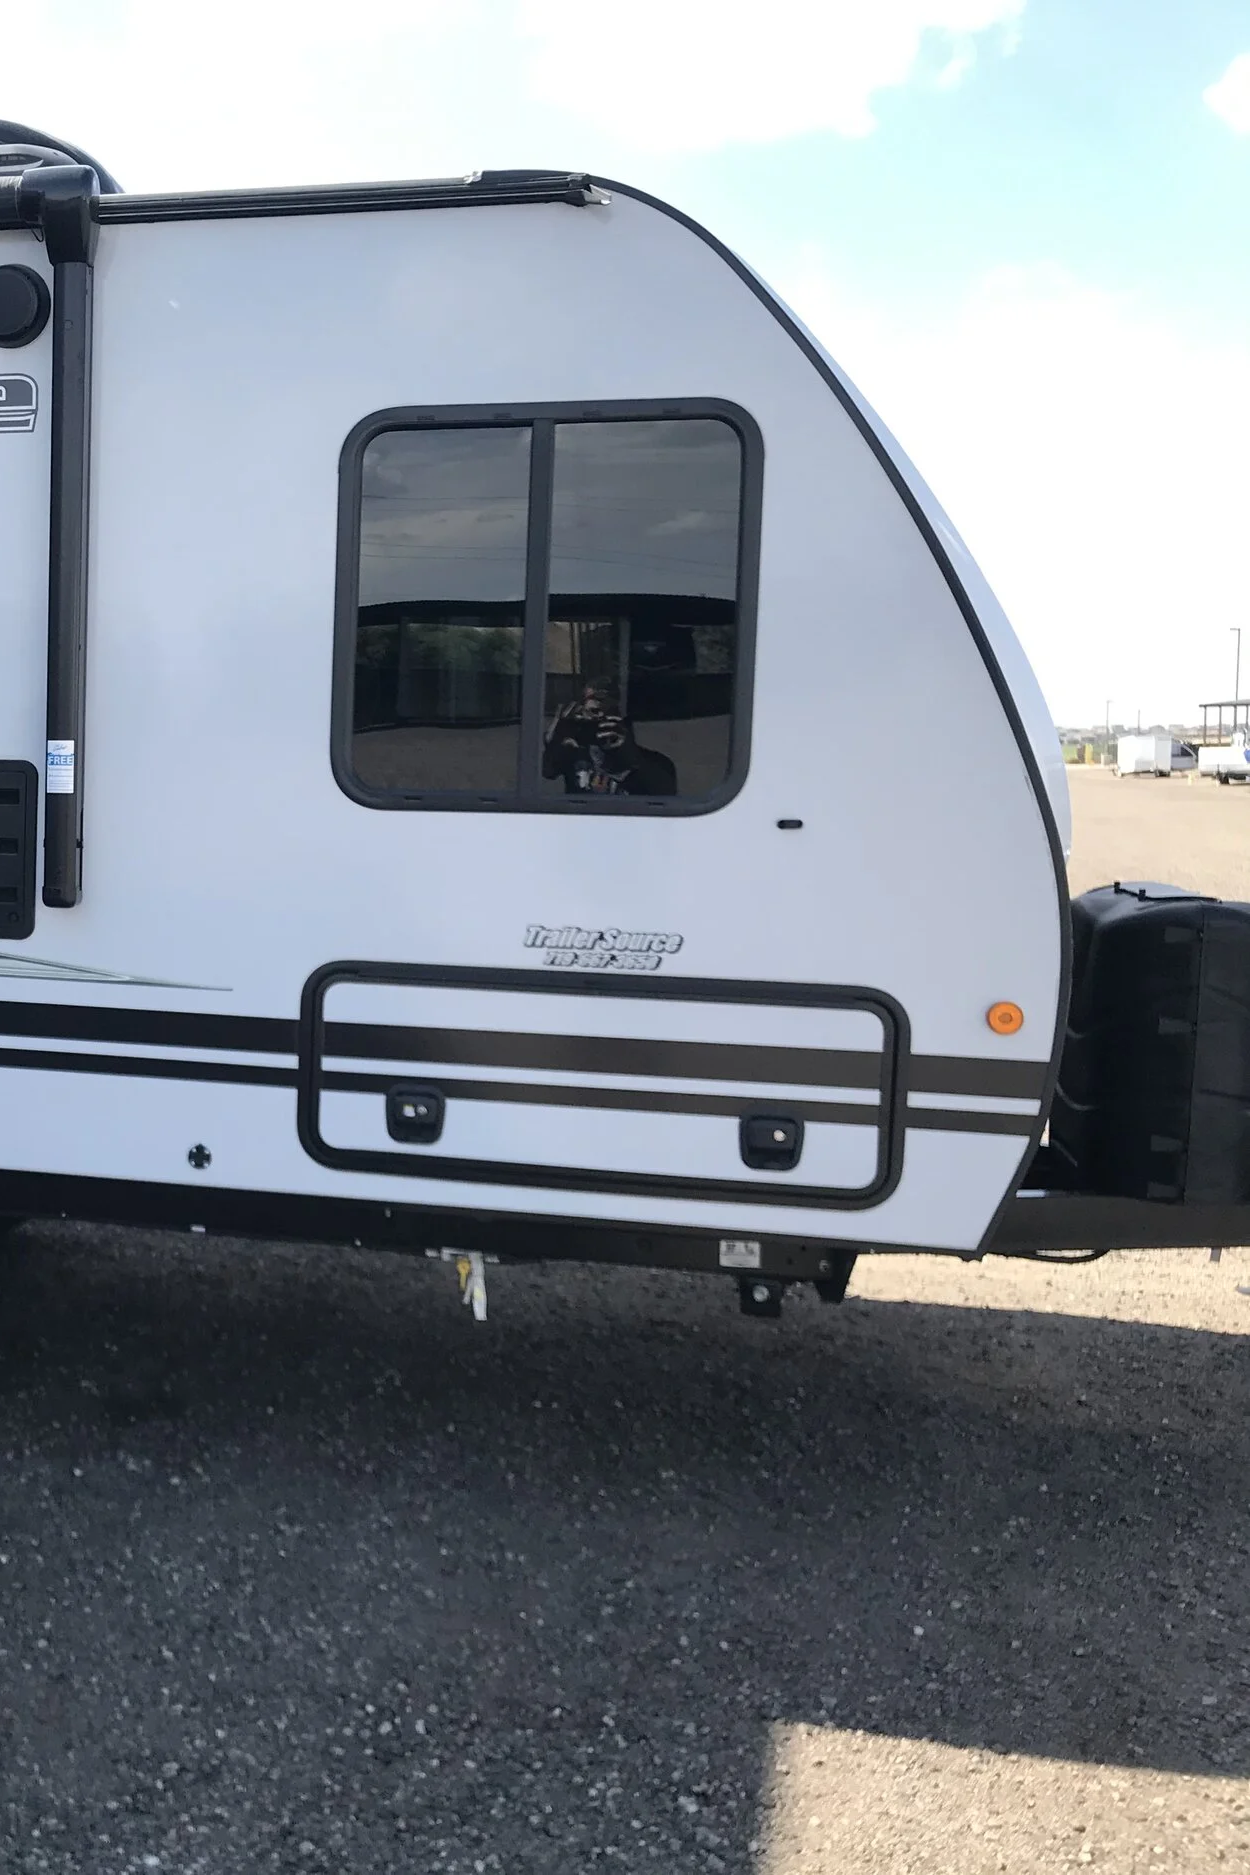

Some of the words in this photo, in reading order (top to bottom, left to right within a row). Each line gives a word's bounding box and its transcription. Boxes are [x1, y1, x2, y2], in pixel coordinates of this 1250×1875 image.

[48, 755, 73, 765] FREE
[523, 925, 603, 950] Trailer
[600, 928, 684, 954] Source
